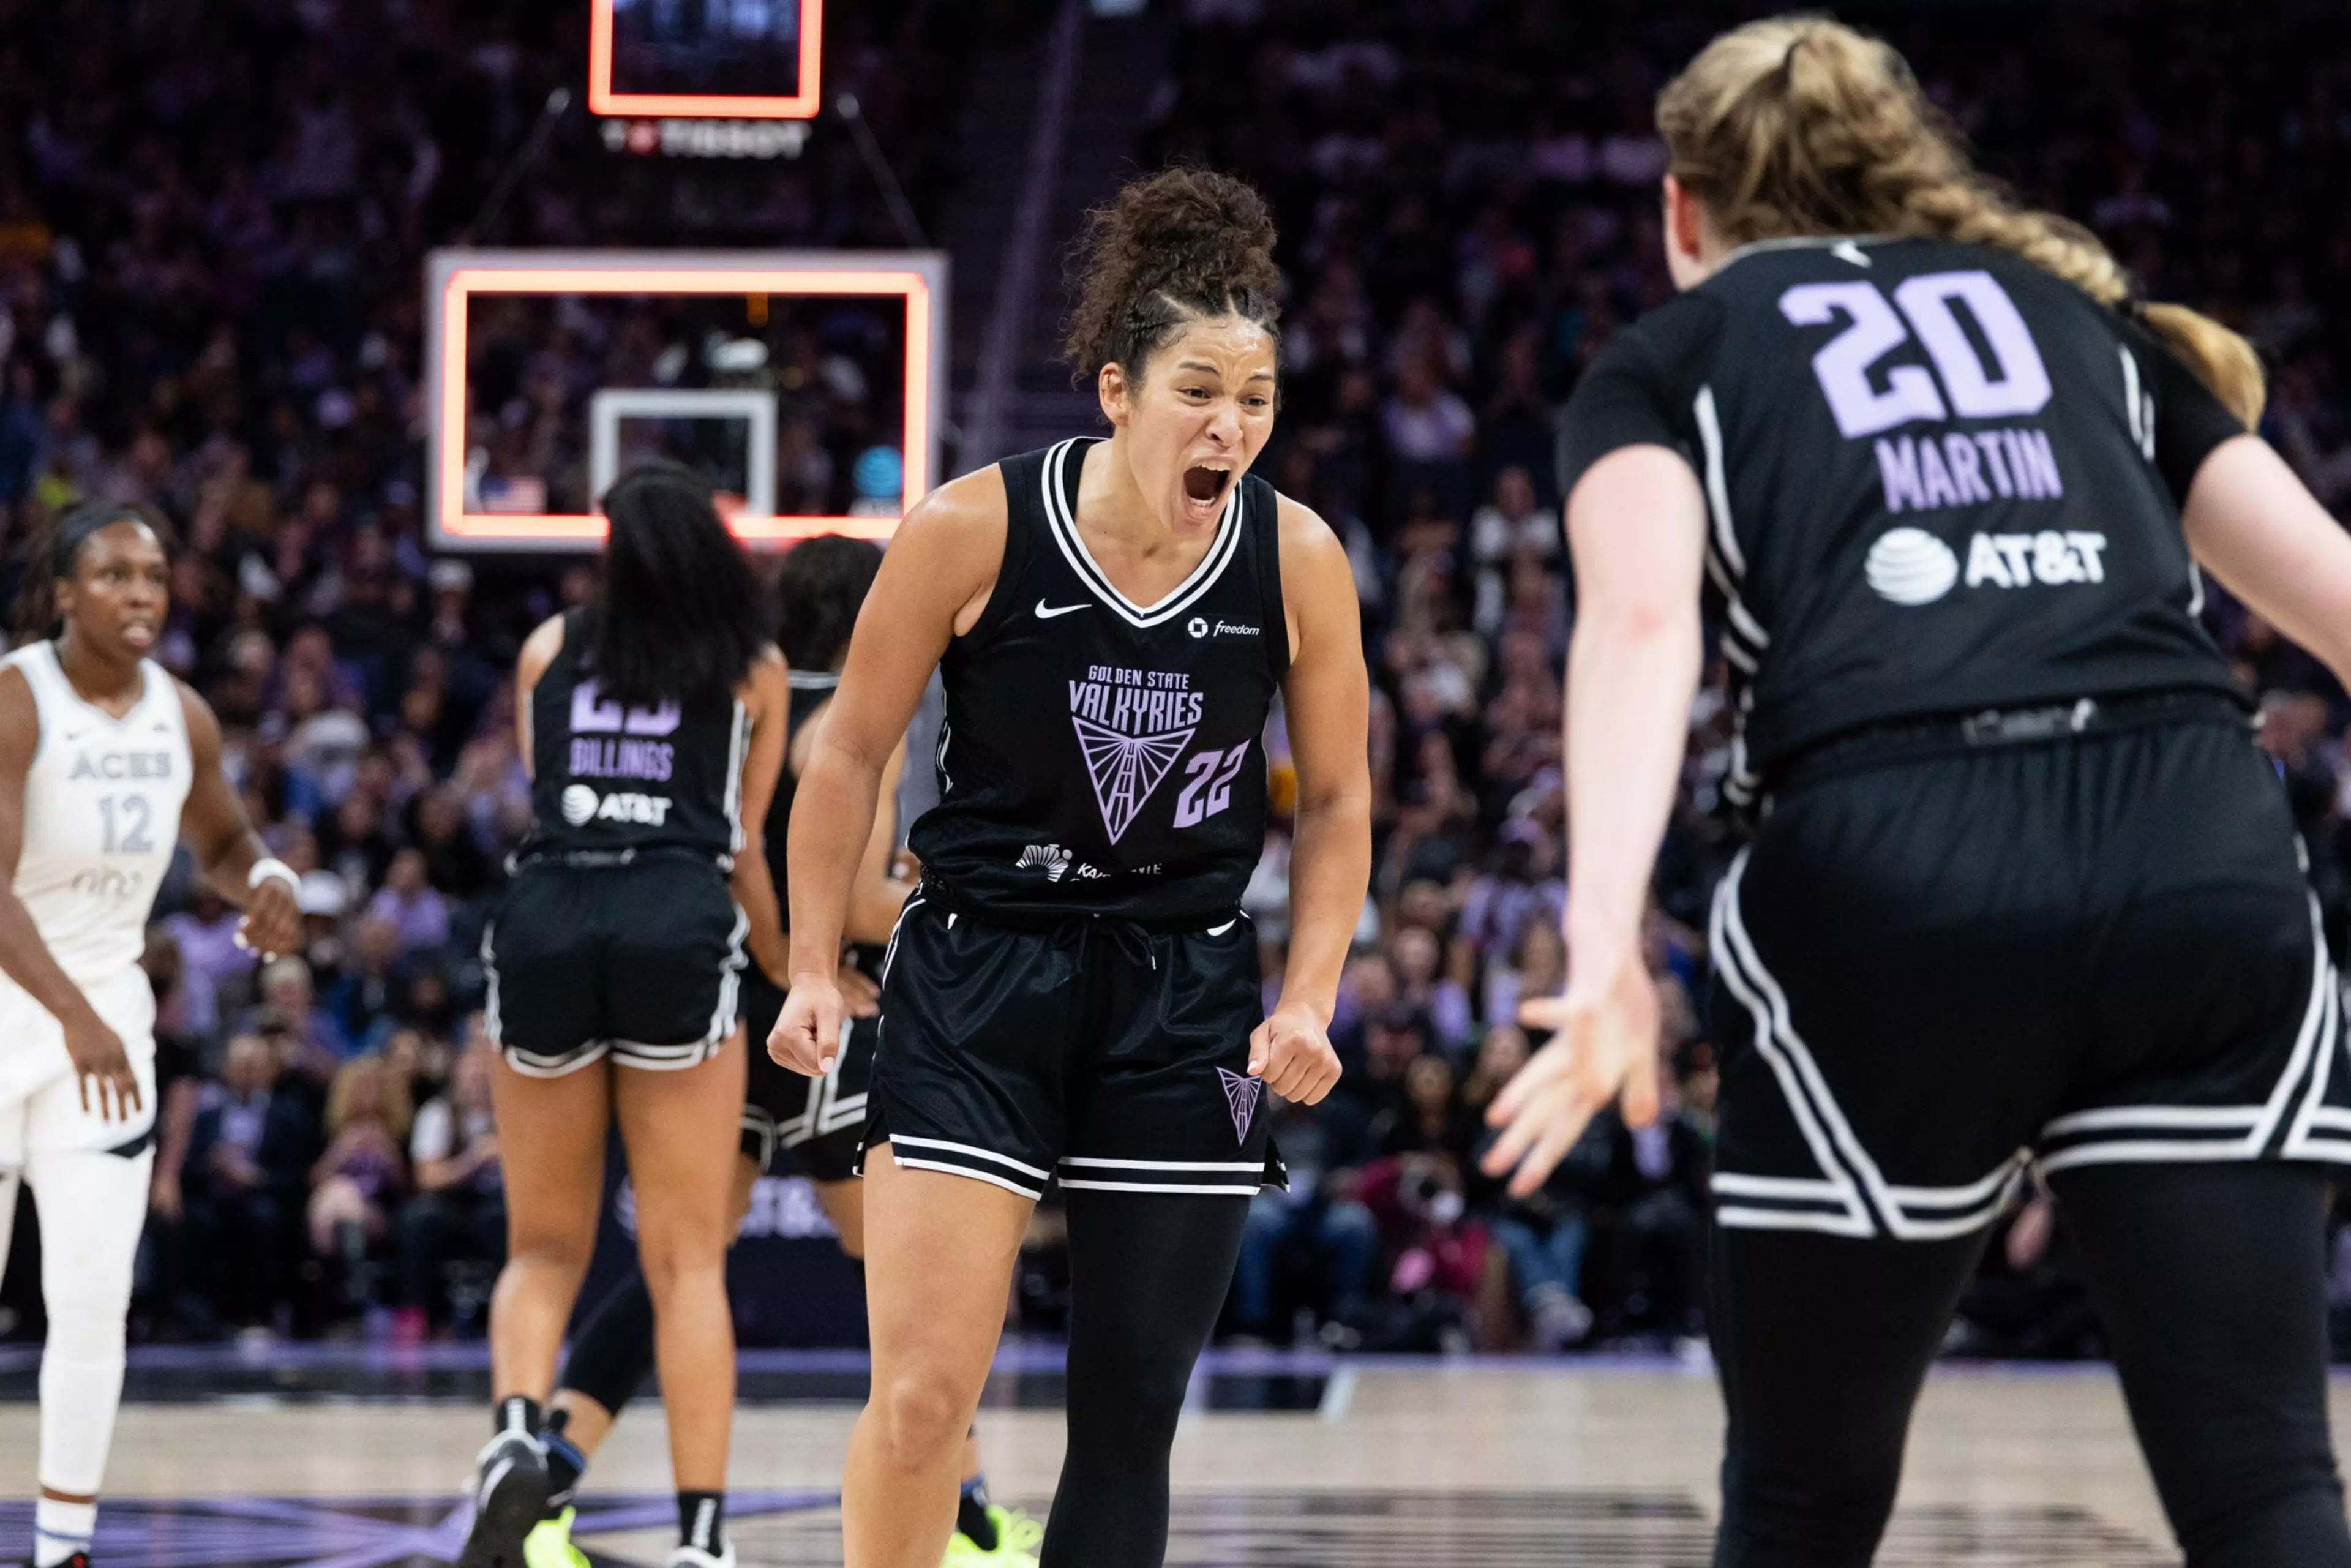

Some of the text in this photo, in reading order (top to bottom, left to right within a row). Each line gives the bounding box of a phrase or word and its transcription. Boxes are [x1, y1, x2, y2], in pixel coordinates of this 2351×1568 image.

[1779, 269, 2053, 439] 20
[1874, 428, 2063, 513] MARTIN
[1965, 530, 2107, 589] AT&T
[1213, 620, 1259, 637] freedom
[1088, 665, 1189, 689] GOLDEN STATE
[1069, 680, 1204, 735] VALKYRIES
[68, 751, 172, 781] ACES
[570, 737, 674, 782] BILLINGS
[1173, 738, 1251, 828] 22
[99, 795, 155, 853] 12
[596, 793, 673, 827] AT&T
